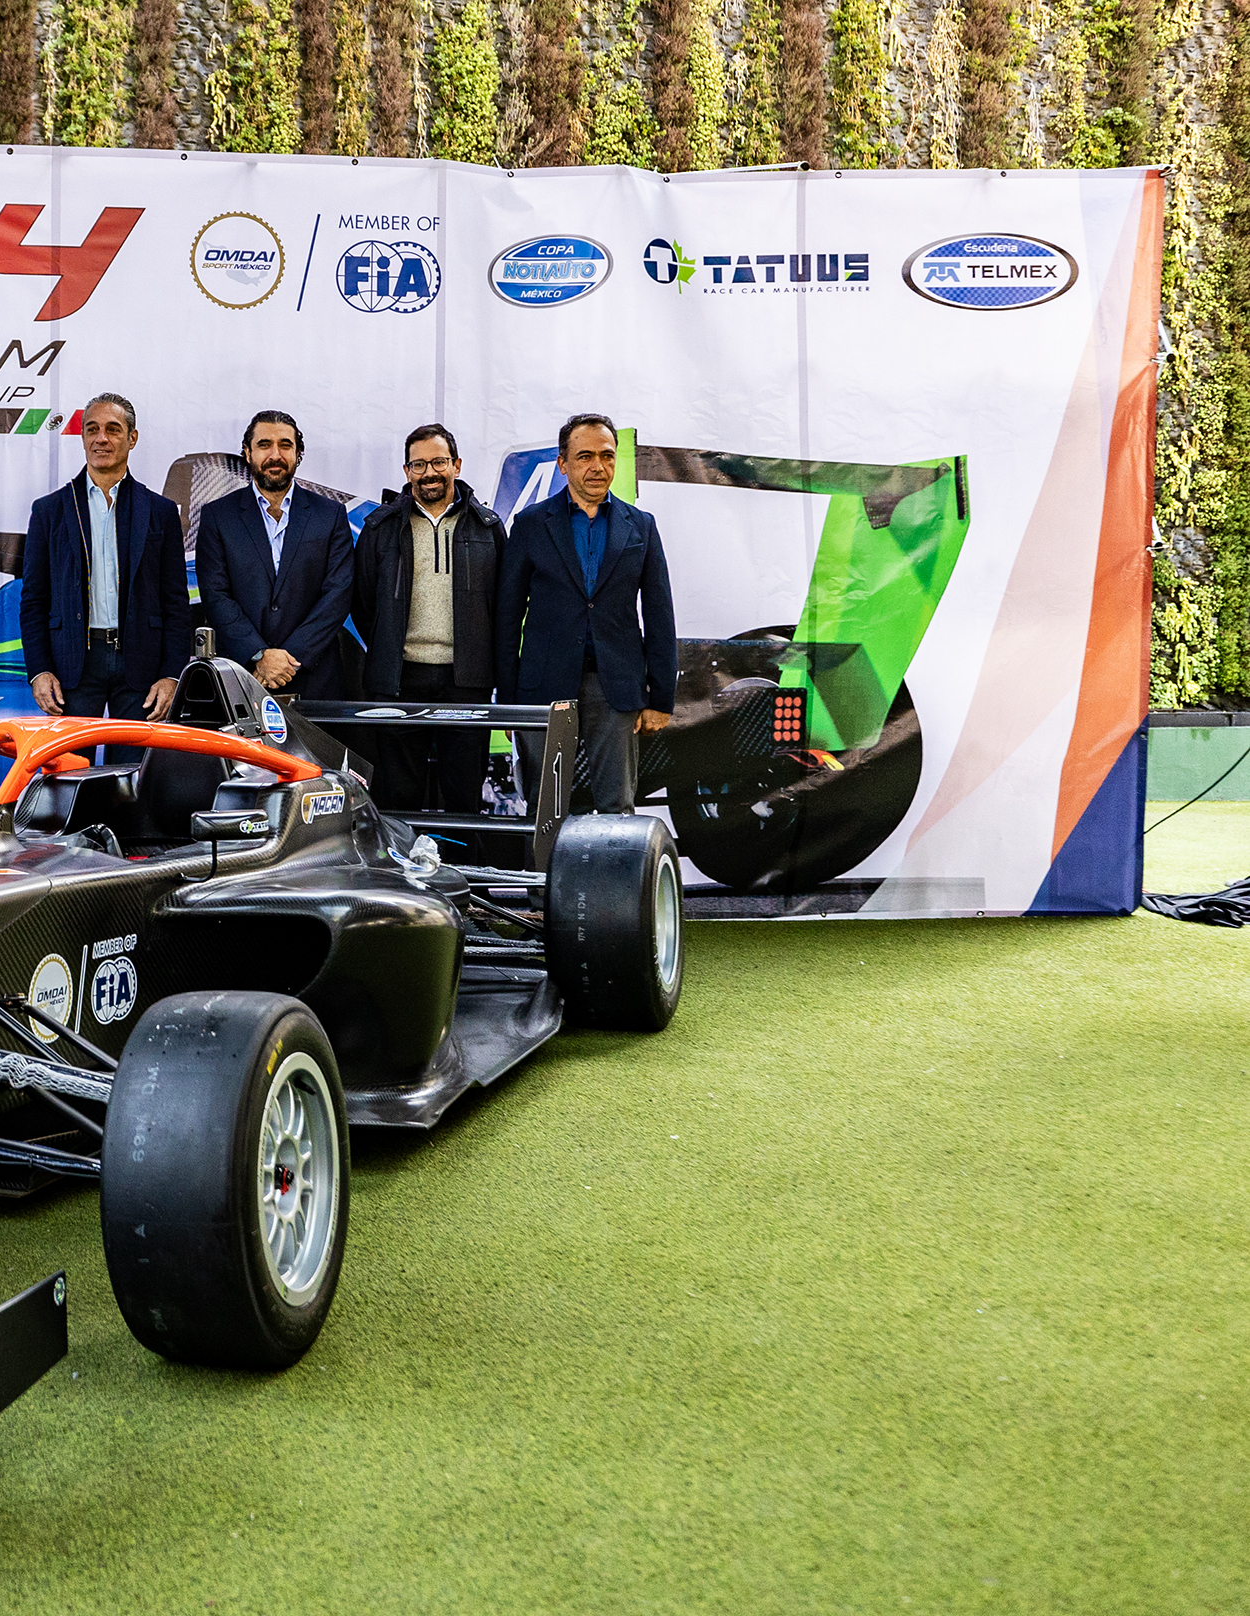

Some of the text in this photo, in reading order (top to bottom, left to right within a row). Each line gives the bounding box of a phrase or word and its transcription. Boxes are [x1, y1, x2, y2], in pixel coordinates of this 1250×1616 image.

[338, 214, 440, 231] MEMBER OF
[204, 249, 276, 262] OMDAI
[537, 245, 574, 255] COPA
[503, 261, 596, 281] NOTIAUTO
[703, 253, 870, 283] TATUUS
[967, 264, 1058, 278] TELMEX
[520, 289, 562, 298] MÉXICO
[92, 933, 138, 960] MEMBER OF
[37, 985, 68, 1003] OMDAI
